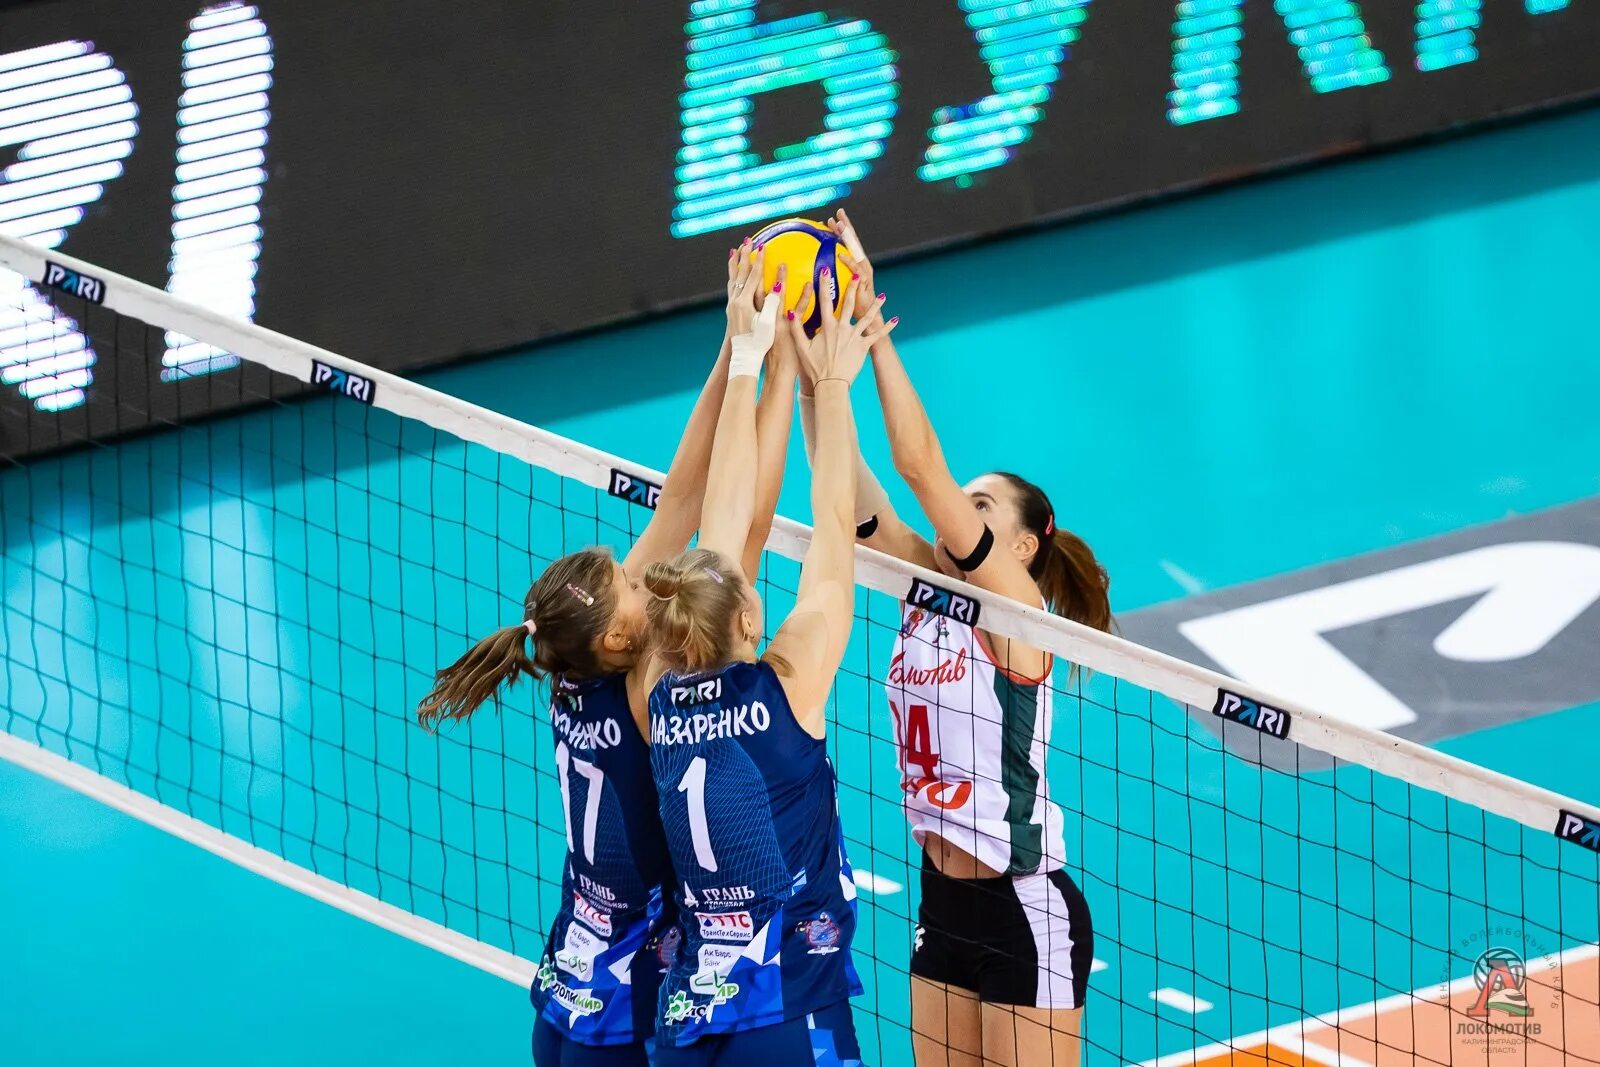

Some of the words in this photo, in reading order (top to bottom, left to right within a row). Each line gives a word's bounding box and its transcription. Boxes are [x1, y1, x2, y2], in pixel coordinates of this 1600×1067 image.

[47, 263, 101, 301] PARI
[314, 362, 373, 401] PARI
[614, 472, 662, 507] PAR
[913, 582, 975, 622] PARI
[671, 677, 722, 704] PARI
[1219, 692, 1285, 736] PARI
[555, 740, 605, 866] 17
[677, 756, 718, 872] 1
[579, 874, 616, 901] ГРАНЬ
[702, 885, 755, 901] ГРАНЬ
